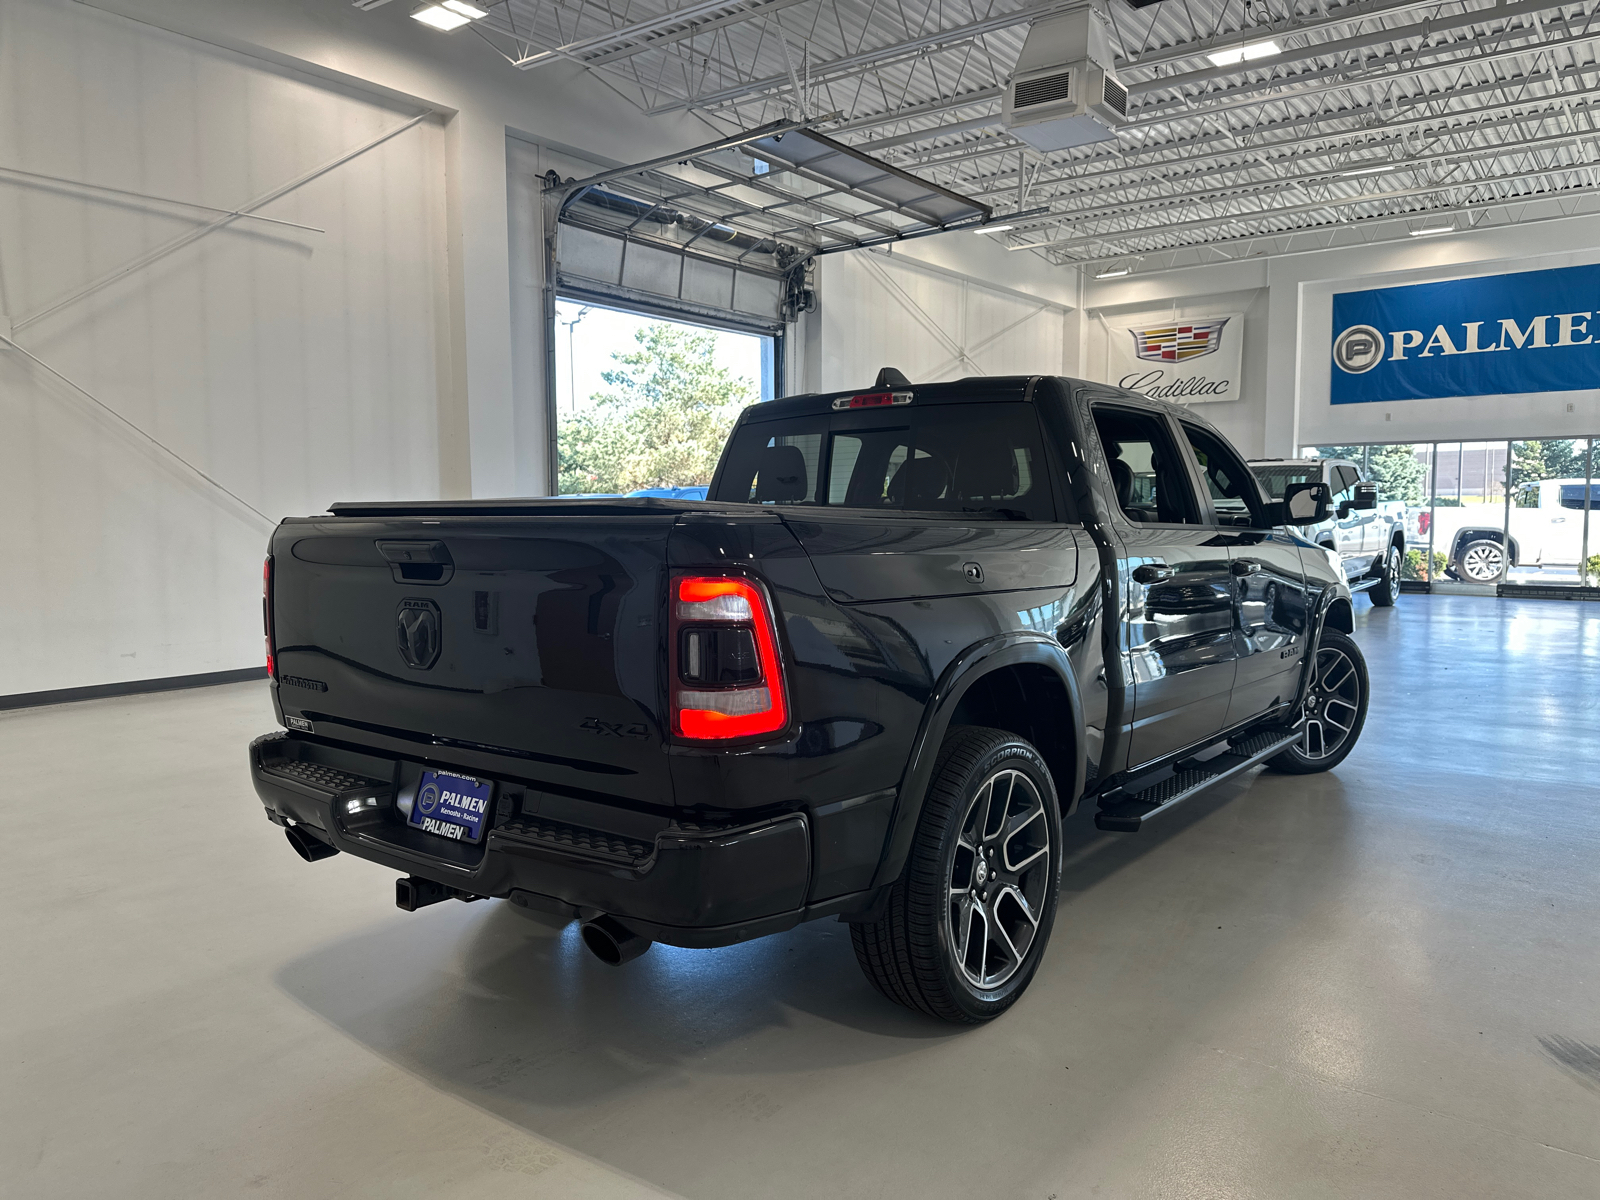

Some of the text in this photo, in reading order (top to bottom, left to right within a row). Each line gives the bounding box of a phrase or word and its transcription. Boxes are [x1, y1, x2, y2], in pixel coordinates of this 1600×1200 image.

[1387, 311, 1600, 361] PALME
[1118, 369, 1229, 398] Cadillac
[404, 601, 430, 609] RAM
[1280, 646, 1299, 659] RAM
[290, 718, 309, 728] PALMEN
[984, 747, 1034, 774] SCORPION
[437, 770, 477, 782] palmen.com
[440, 790, 487, 814] PALMEN
[440, 807, 461, 818] Kenosha
[422, 817, 464, 840] PALMEN
